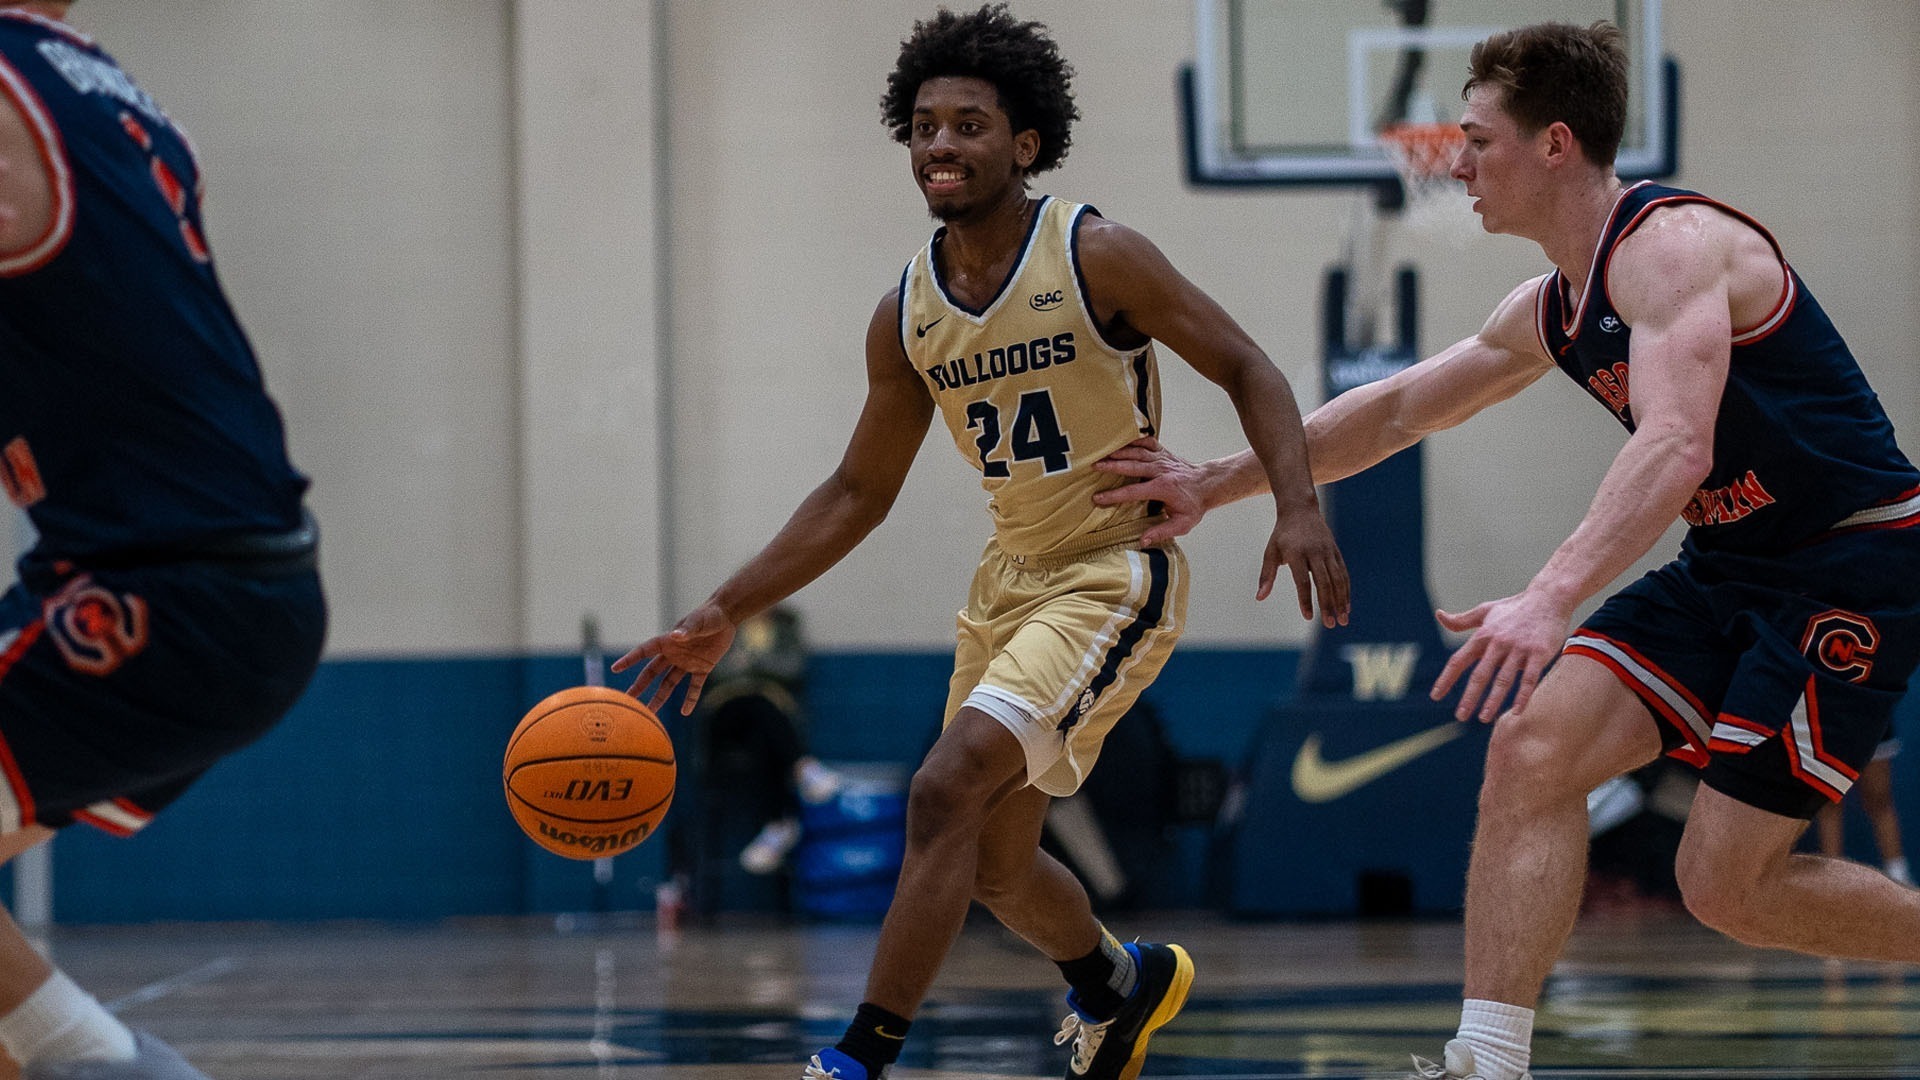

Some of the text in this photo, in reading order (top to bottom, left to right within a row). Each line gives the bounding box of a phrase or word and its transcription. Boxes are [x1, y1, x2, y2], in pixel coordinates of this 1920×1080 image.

[1034, 290, 1064, 307] SAC
[1603, 317, 1619, 329] SA
[926, 332, 1076, 391] BULLDOGS
[965, 388, 1073, 479] 24
[563, 778, 634, 801] EVO
[537, 820, 651, 853] Wilson
